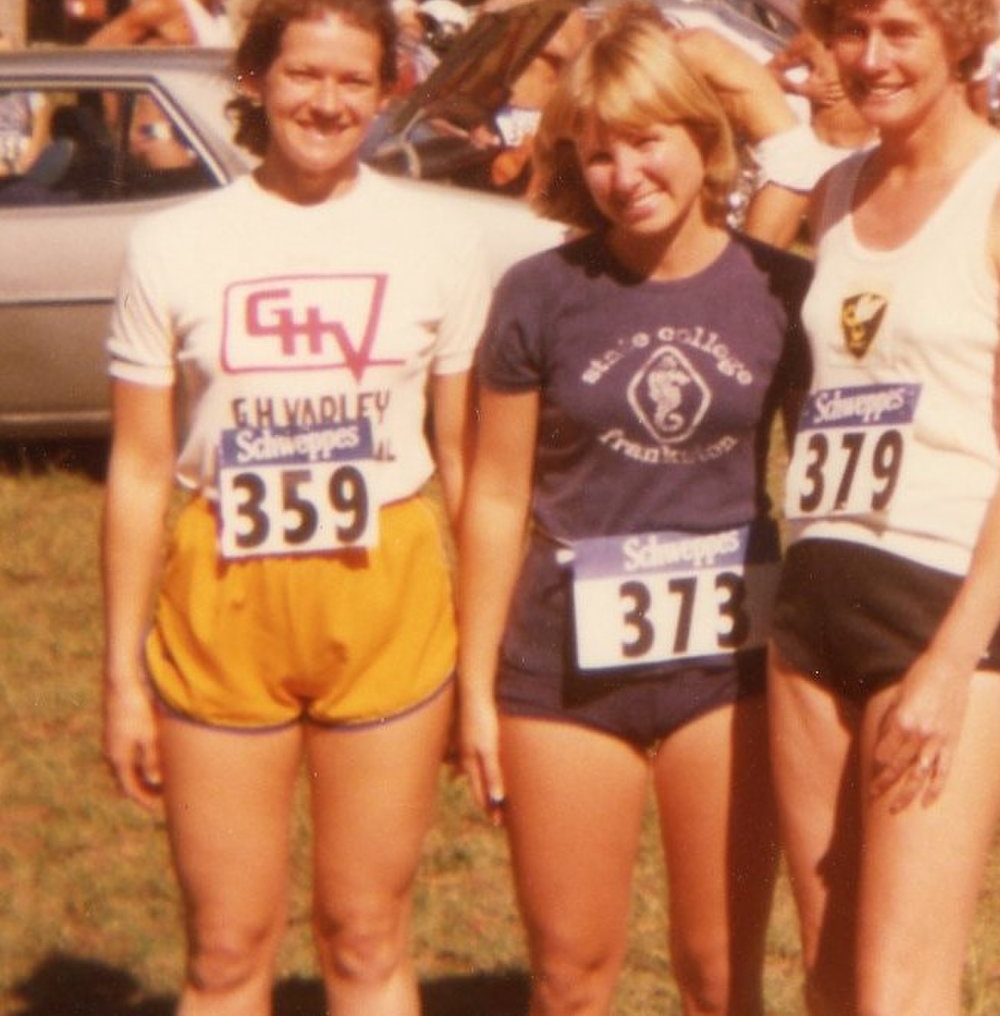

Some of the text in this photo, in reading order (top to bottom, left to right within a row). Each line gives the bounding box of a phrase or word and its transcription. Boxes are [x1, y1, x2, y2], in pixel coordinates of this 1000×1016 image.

[581, 332, 650, 384] stae
[812, 388, 905, 424] Schweppes
[236, 428, 359, 462] Schweppes
[799, 429, 905, 514] 379
[231, 465, 368, 548] 359
[621, 530, 741, 572] Schweppes
[618, 571, 750, 659] 373
